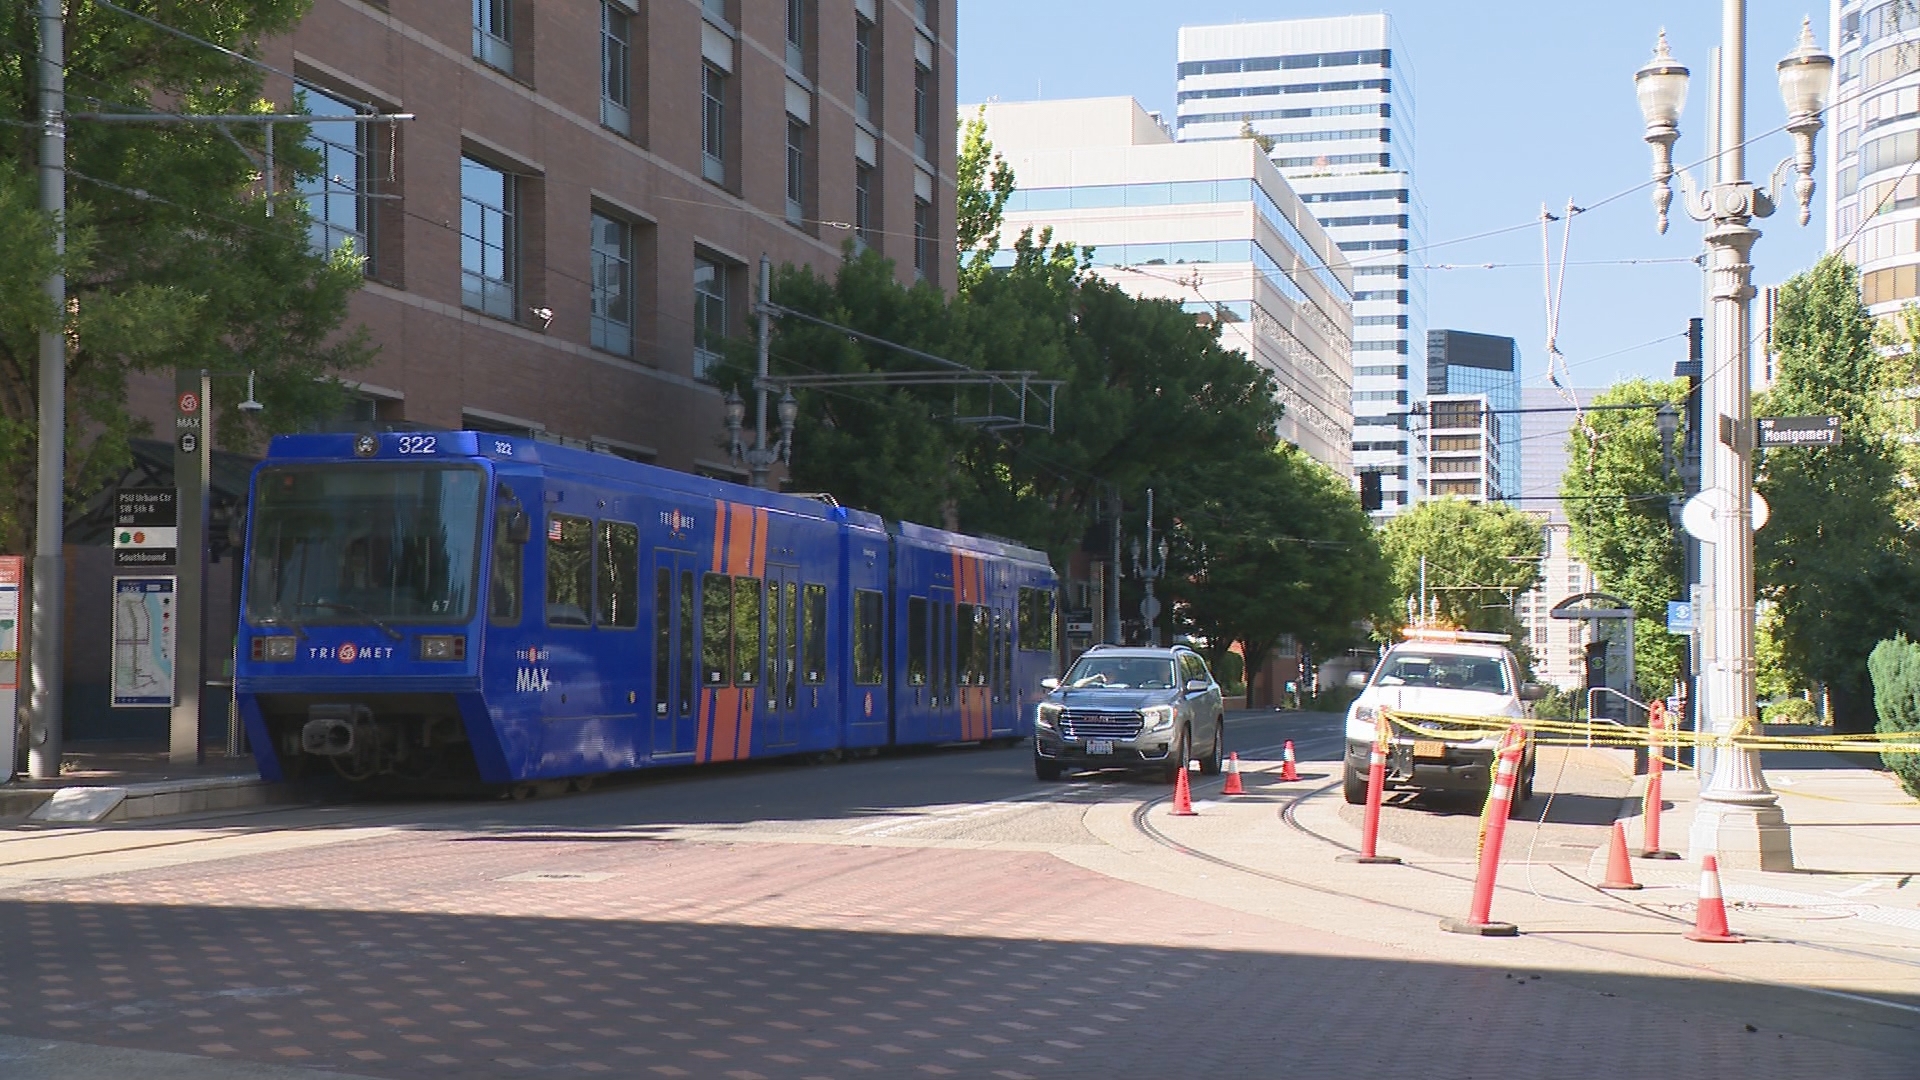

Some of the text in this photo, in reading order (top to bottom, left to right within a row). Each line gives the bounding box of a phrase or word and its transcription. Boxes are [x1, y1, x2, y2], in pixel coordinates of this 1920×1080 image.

[177, 418, 200, 428] MAX
[1760, 416, 1839, 428] SW ST
[1764, 428, 1836, 443] Montgomery
[398, 436, 436, 454] 322
[494, 440, 512, 456] 322
[120, 493, 134, 502] PSU
[120, 504, 132, 513] SW
[119, 552, 167, 562] Southbound
[309, 647, 394, 659] TRI MET
[516, 667, 549, 692] MAX
